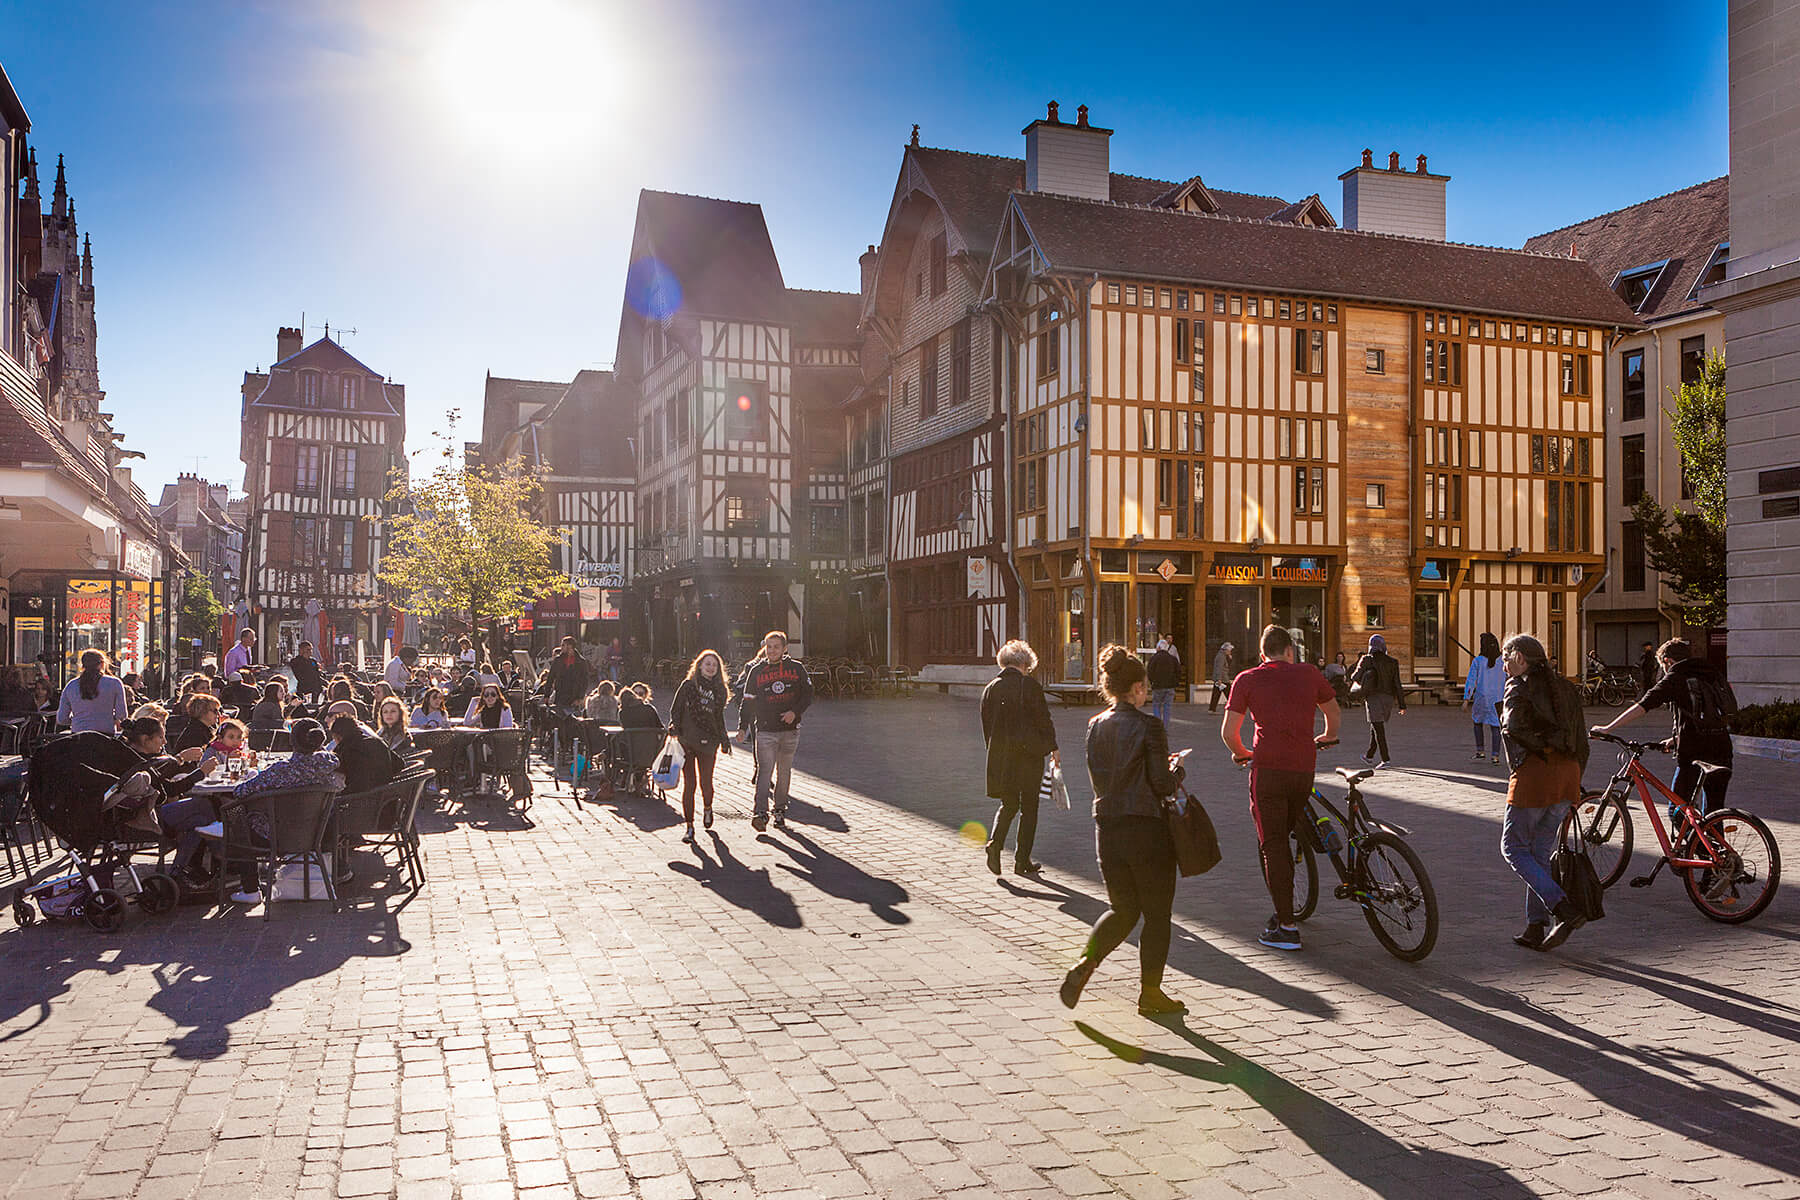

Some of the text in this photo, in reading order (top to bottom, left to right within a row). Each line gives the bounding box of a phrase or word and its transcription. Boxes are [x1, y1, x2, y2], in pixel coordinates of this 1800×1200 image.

[576, 560, 620, 573] TAVERNE
[1215, 566, 1328, 582] MAISON TOURISME
[126, 592, 139, 674] BRASSERI
